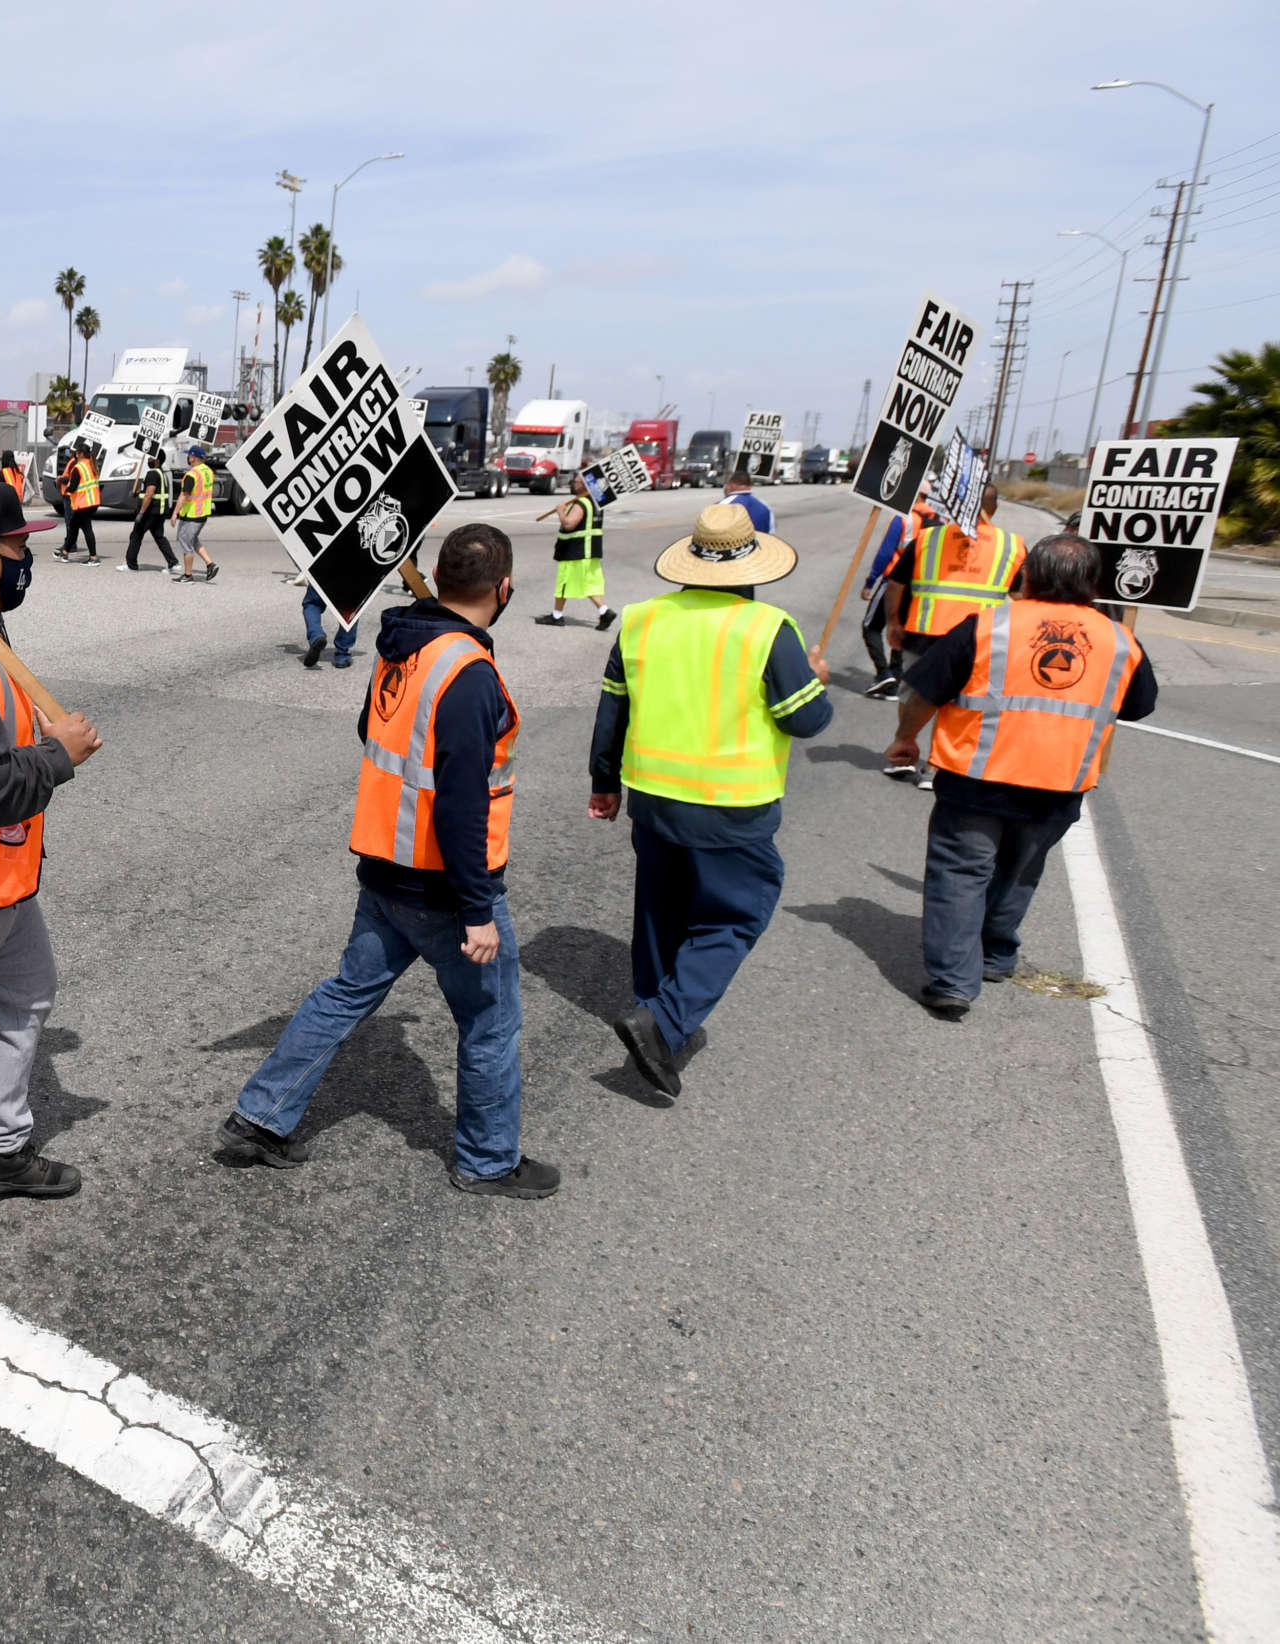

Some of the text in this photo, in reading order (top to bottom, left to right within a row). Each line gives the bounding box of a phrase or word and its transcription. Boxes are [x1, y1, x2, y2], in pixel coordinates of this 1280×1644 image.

[916, 299, 974, 366] FAIR
[900, 346, 960, 401] CONTRACT
[145, 409, 165, 424] FAIR
[200, 395, 222, 408] FAIR
[246, 340, 370, 490] FAIR
[886, 383, 946, 442] NOW
[141, 426, 161, 441] NOW
[195, 413, 218, 426] NOW
[749, 413, 781, 428] FAIR
[271, 373, 394, 526] CONTRACT
[742, 440, 776, 452] NOW
[1102, 447, 1218, 478] FAIR
[294, 407, 407, 558] NOW
[602, 461, 626, 494] NOW
[623, 449, 647, 484] FAIR
[1091, 484, 1216, 510] CONTRACT
[1089, 511, 1204, 546] NOW
